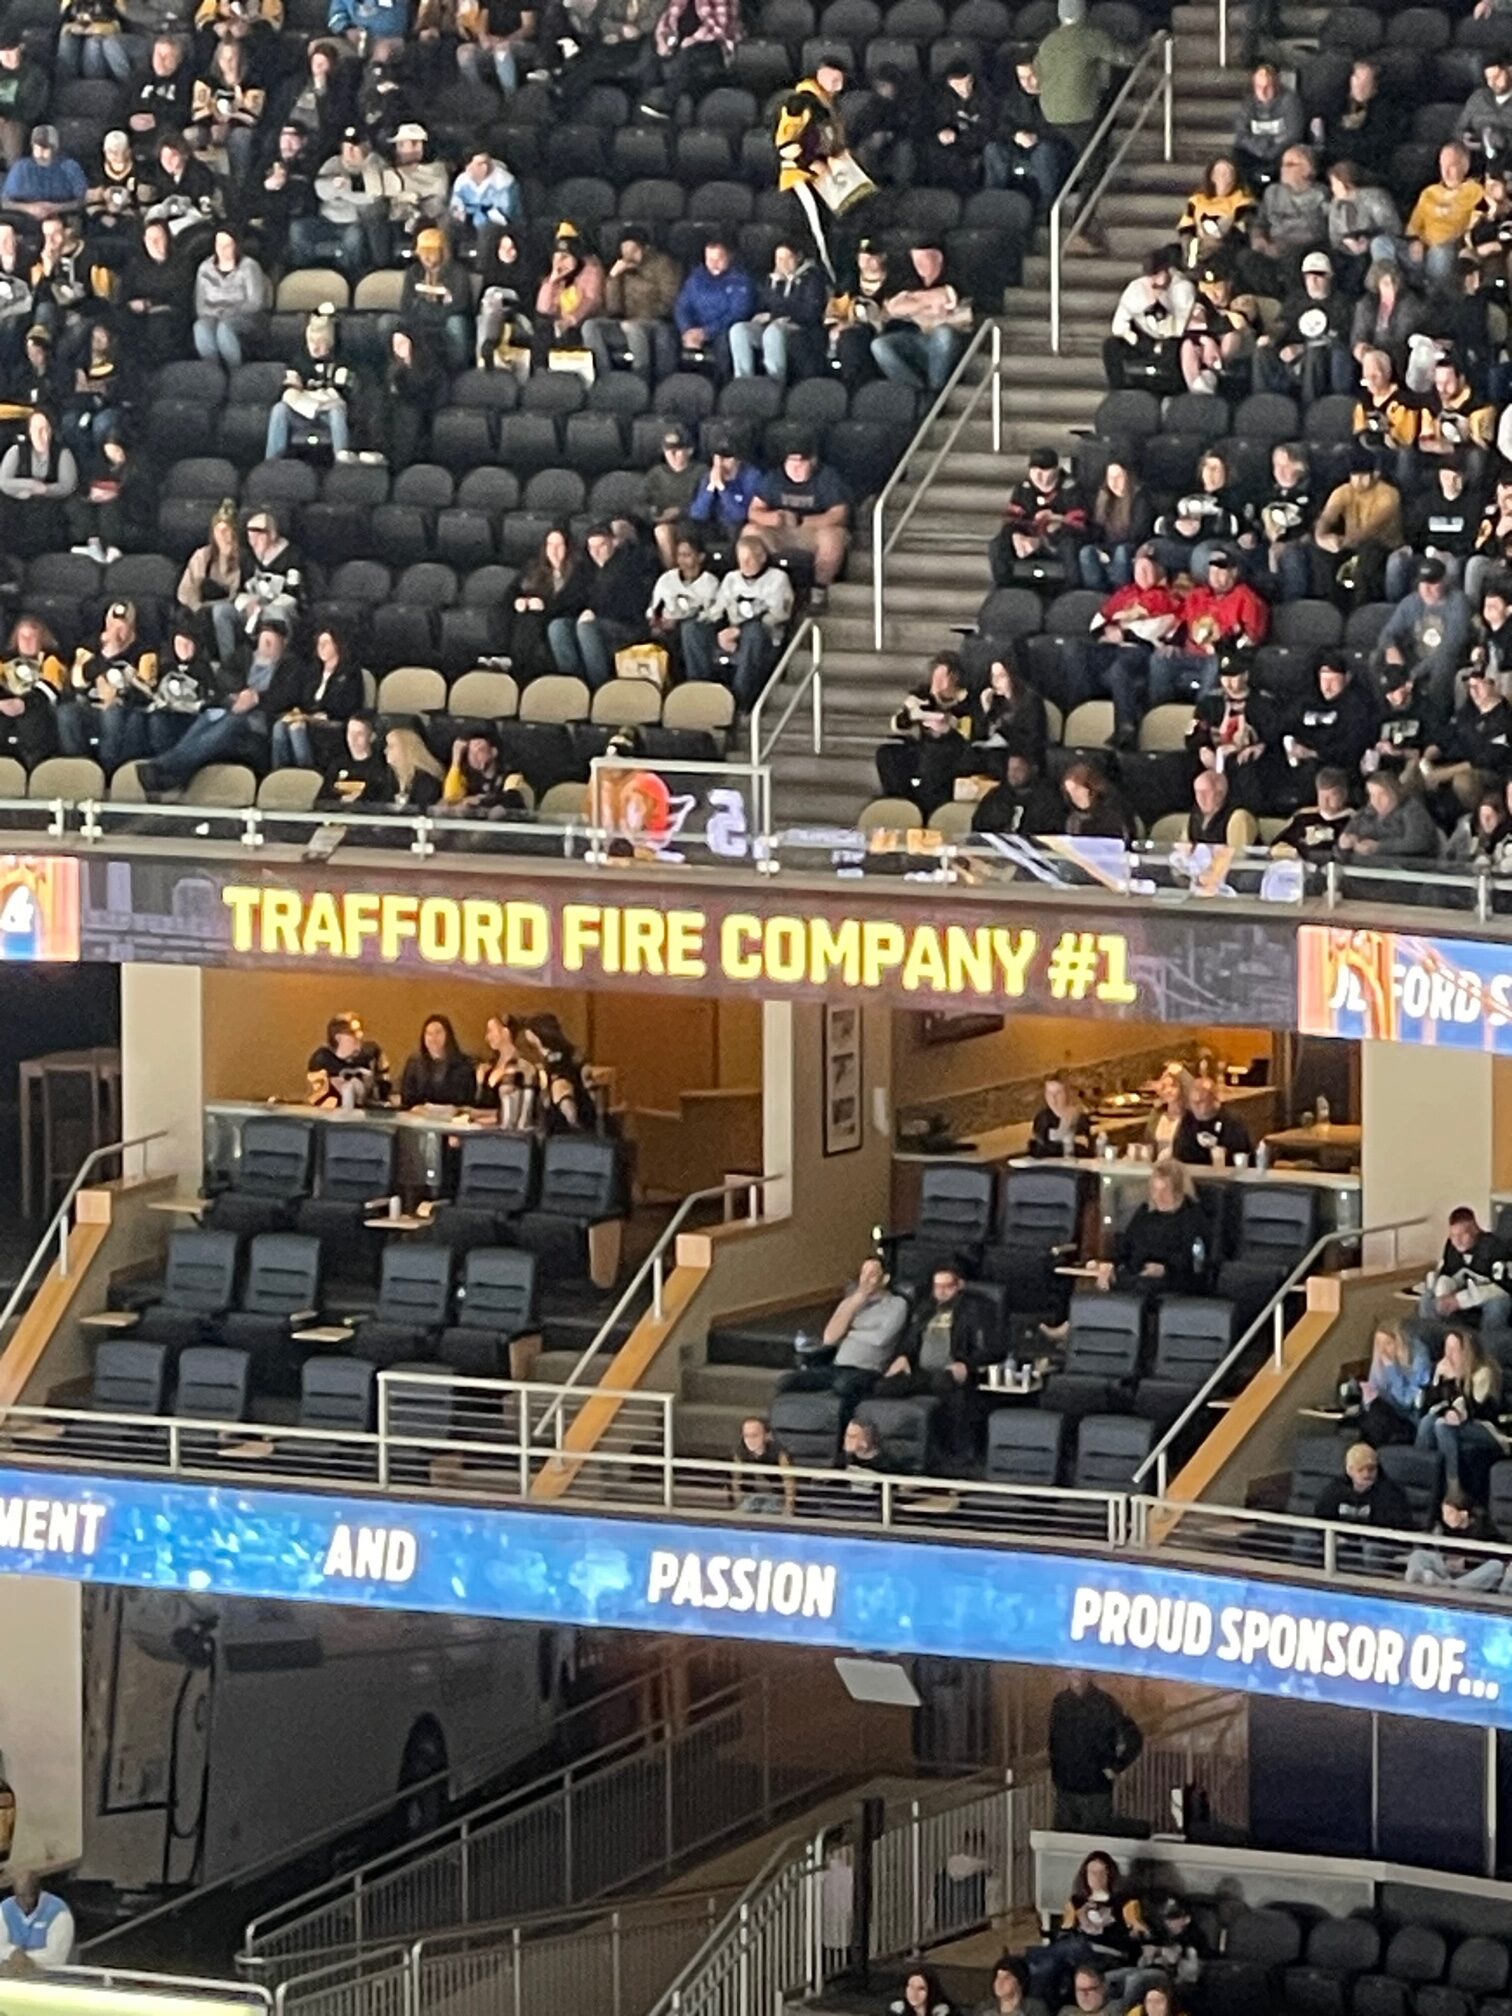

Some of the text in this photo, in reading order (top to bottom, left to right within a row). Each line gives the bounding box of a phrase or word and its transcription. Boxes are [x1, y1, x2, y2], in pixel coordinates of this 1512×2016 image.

[222, 886, 1138, 1003] TRAFFORD FIRE COMPANY #1
[0, 1497, 838, 1618] MENT AND PASSION
[1070, 1587, 1499, 1700] PROUD SPONSOR OF...
